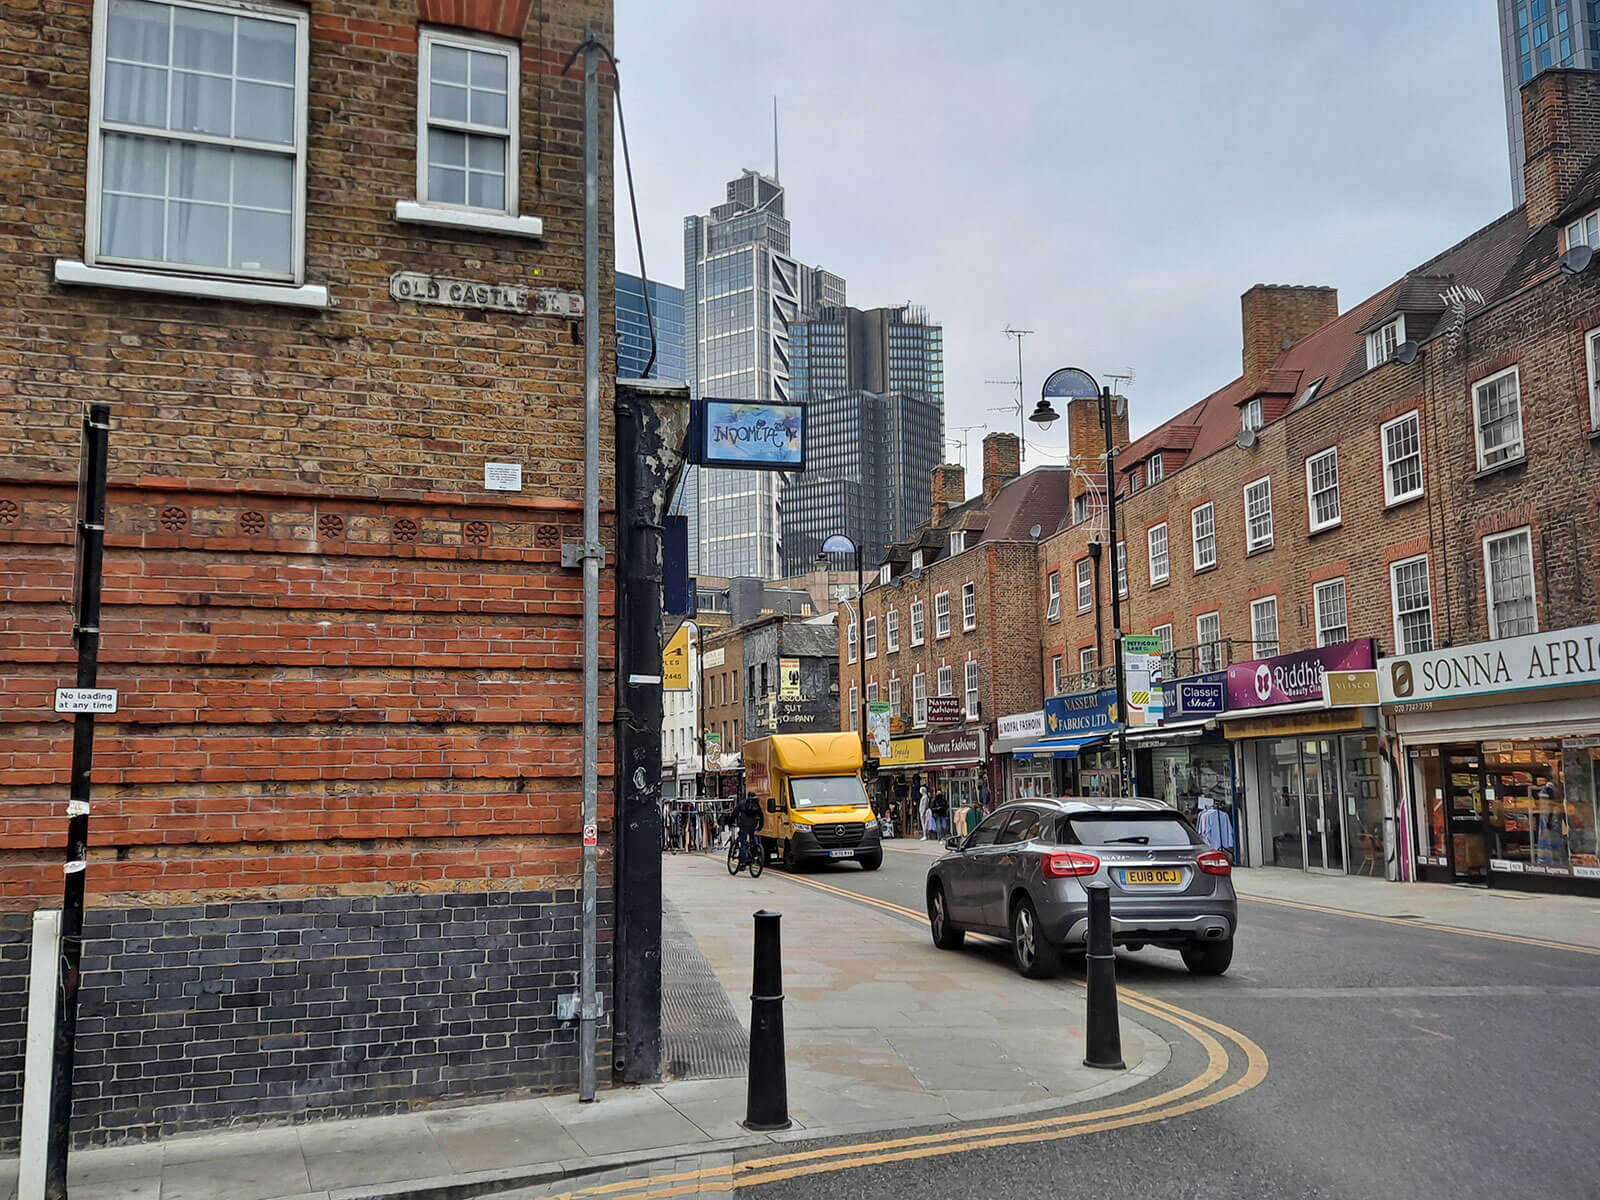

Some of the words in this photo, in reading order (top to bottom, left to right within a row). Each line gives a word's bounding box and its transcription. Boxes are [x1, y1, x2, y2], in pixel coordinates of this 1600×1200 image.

[399, 279, 441, 298] OLD
[449, 284, 527, 308] CASTLE
[1422, 651, 1513, 692] SONNA
[1527, 637, 1600, 679] AFRI
[1274, 659, 1325, 695] Riddhi's
[78, 692, 113, 701] loading
[1183, 686, 1219, 697] Classic
[72, 702, 89, 710] any
[1064, 695, 1099, 711] NASSERI
[1059, 716, 1091, 731] FABRICS
[1092, 713, 1108, 728] LTD
[1130, 871, 1154, 882] EU18
